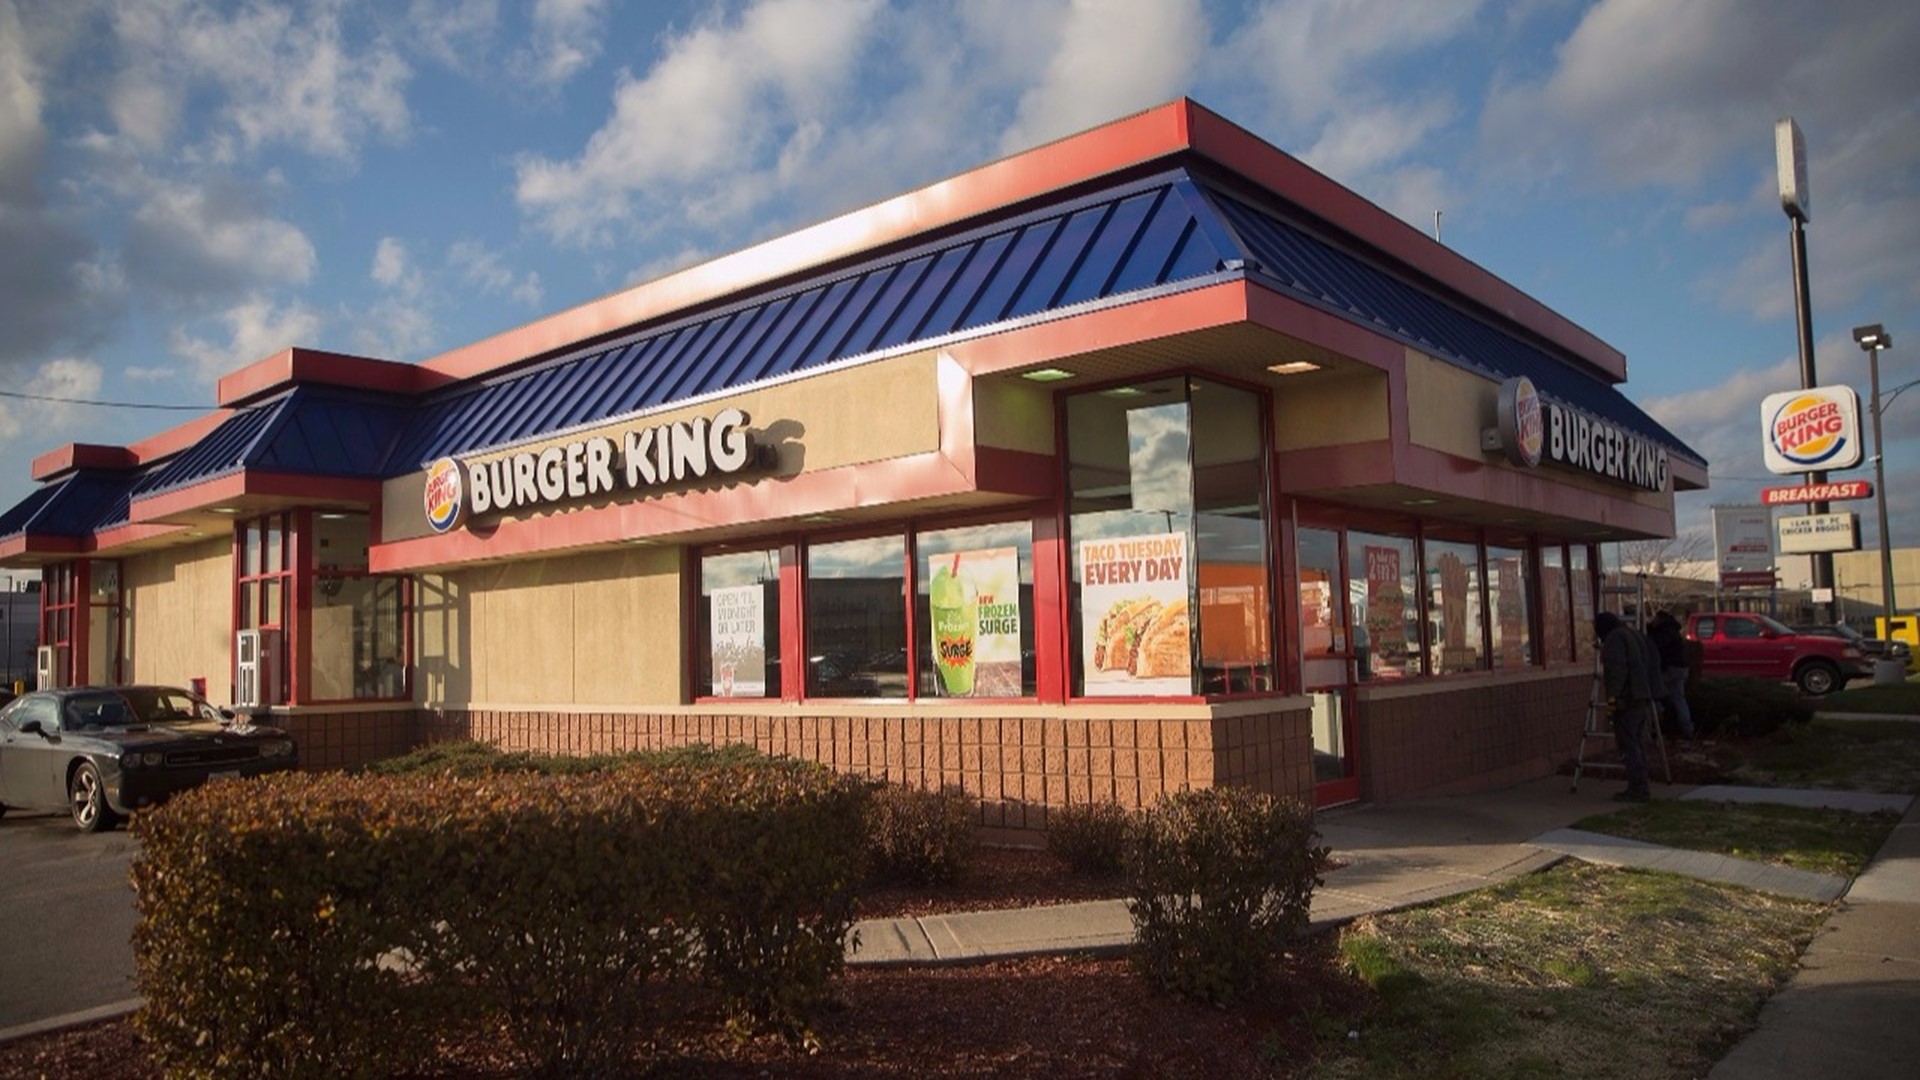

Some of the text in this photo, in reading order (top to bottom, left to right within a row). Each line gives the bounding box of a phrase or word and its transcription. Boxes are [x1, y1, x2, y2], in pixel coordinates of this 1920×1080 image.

[1777, 402, 1837, 435] BURGER
[1550, 403, 1667, 493] BURGER KING
[1781, 416, 1842, 454] KING
[469, 407, 747, 513] BURGER KING
[428, 484, 456, 515] KING
[1768, 483, 1860, 503] BREAKFAST
[1781, 523, 1850, 536] CHICKEN NUGGETS
[1084, 538, 1181, 561] TACO TUESDAY
[1085, 556, 1182, 587] EVERY DAY
[978, 603, 1017, 619] FROZEN
[979, 618, 1018, 636] SURGE
[940, 639, 973, 658] SURGE
